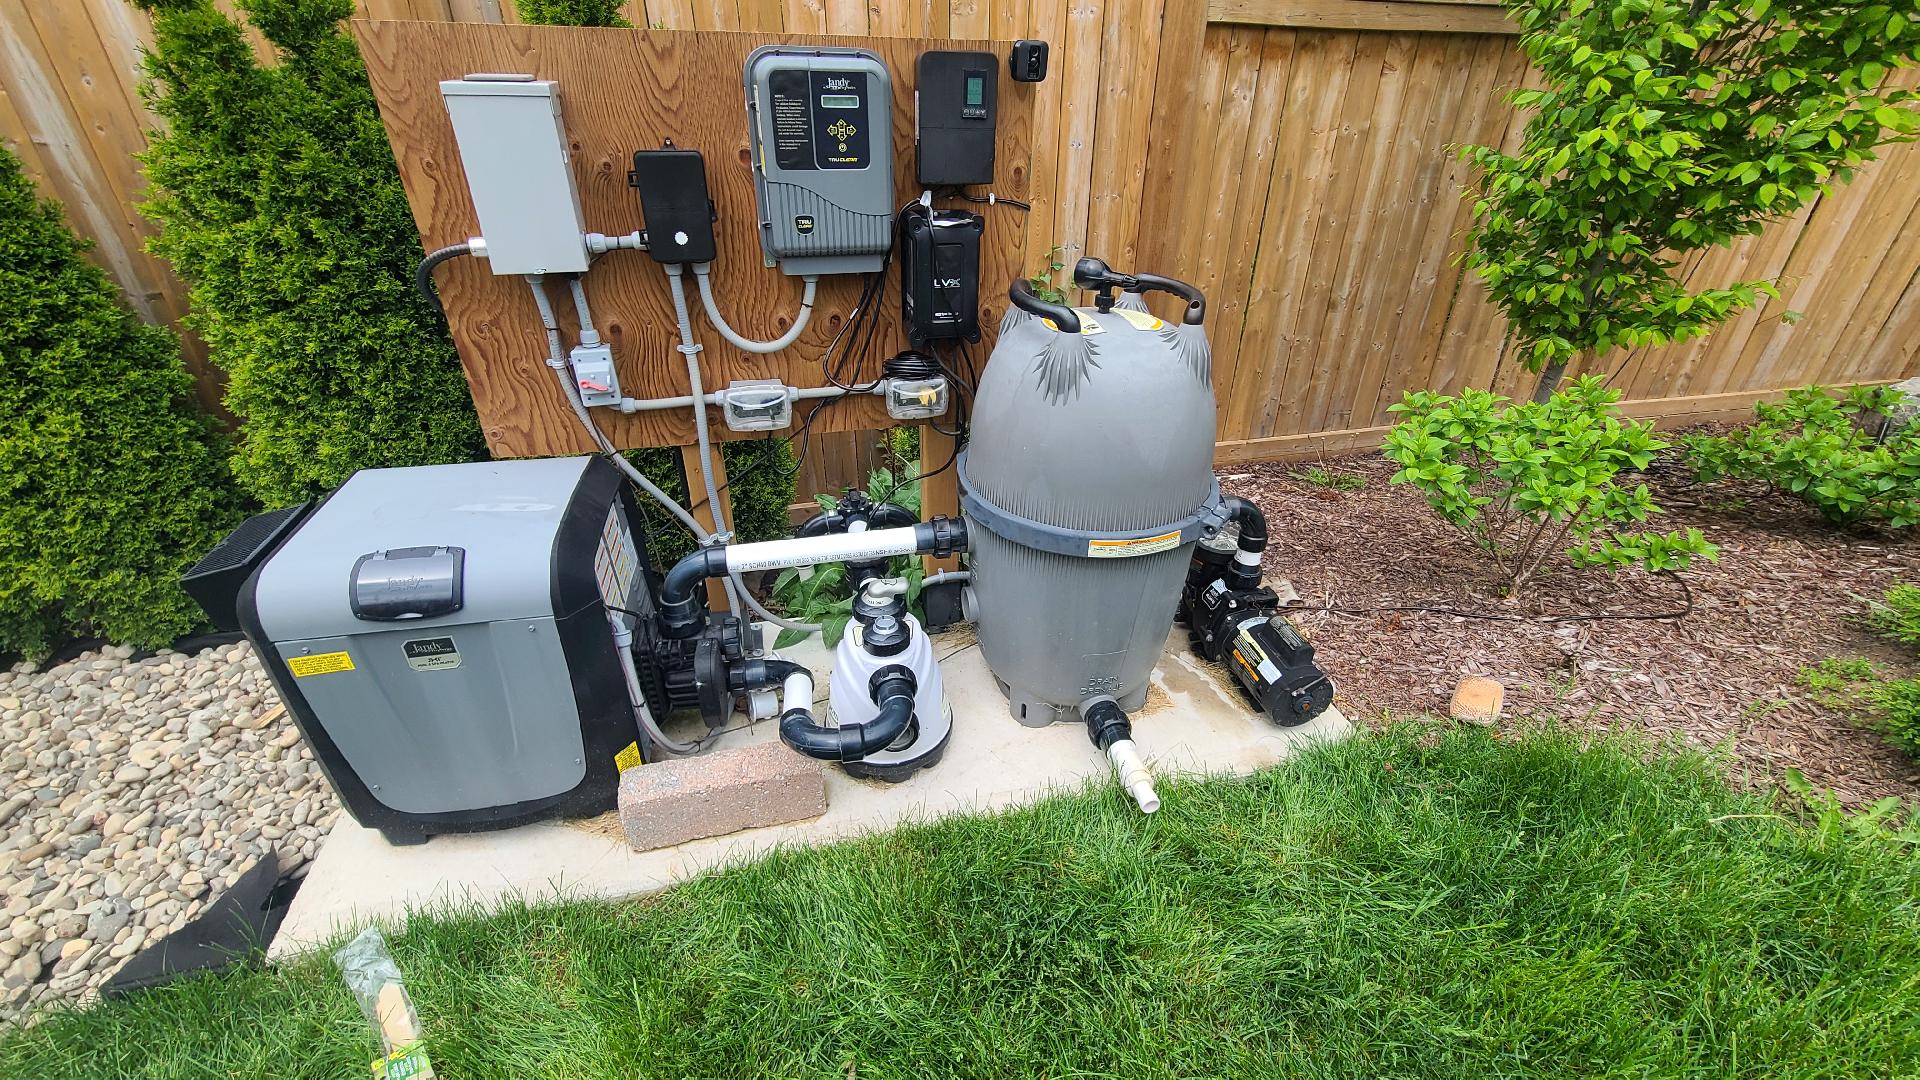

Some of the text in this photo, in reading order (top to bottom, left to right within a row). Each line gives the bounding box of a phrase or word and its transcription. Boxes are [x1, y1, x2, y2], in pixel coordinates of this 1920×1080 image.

[825, 77, 850, 88] Jandy
[411, 641, 441, 653] Jandy
[1089, 676, 1119, 686] DRAIN
